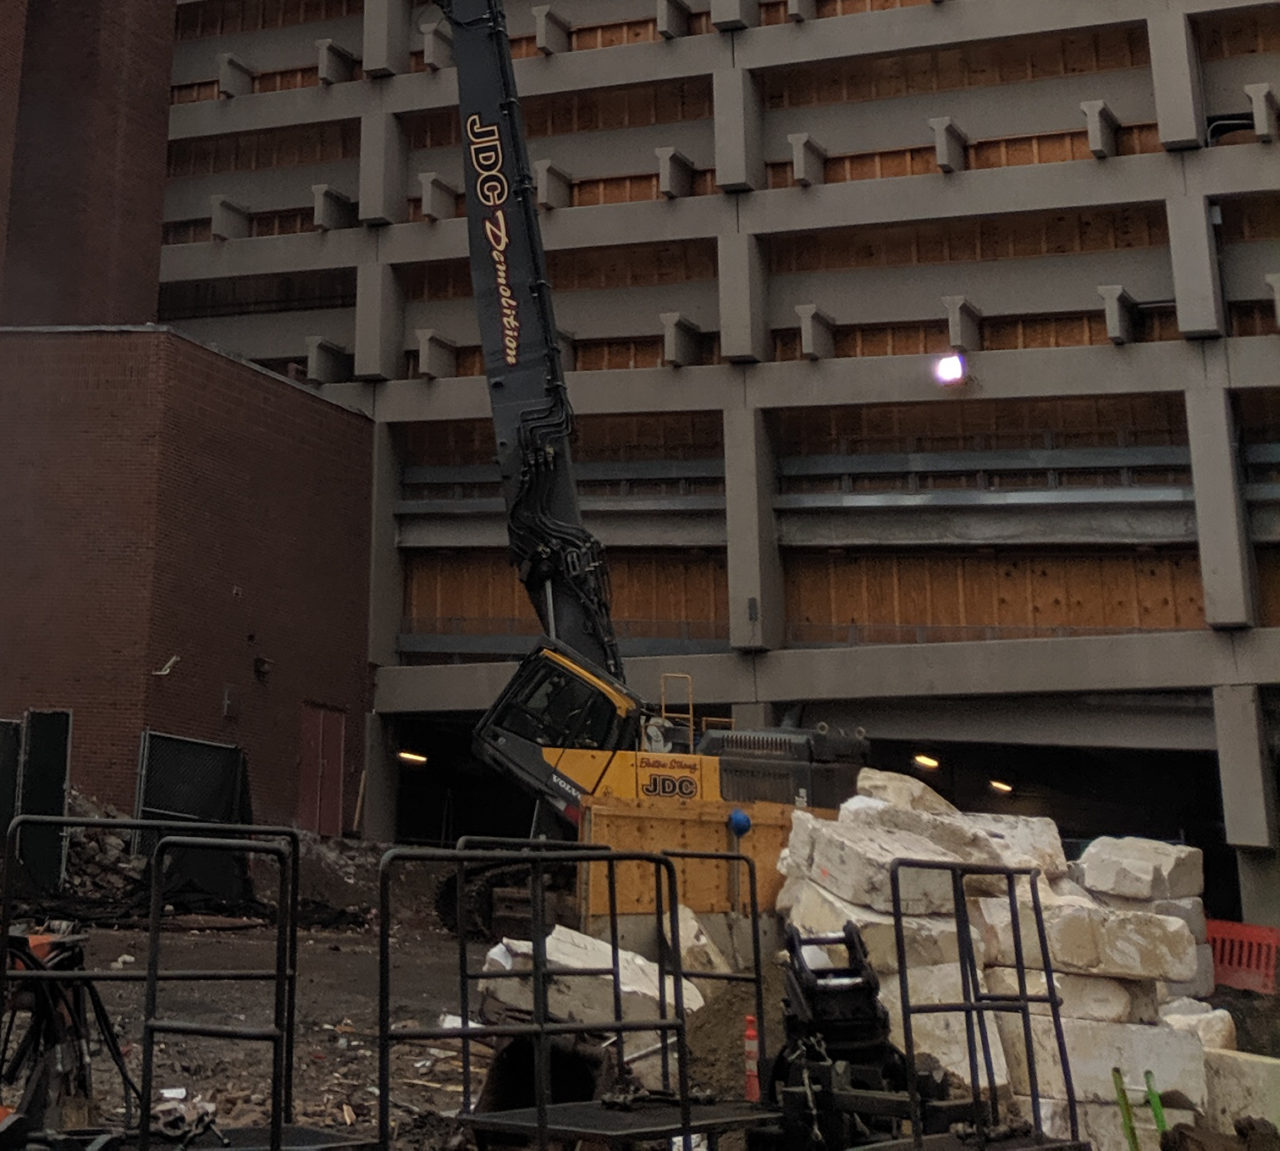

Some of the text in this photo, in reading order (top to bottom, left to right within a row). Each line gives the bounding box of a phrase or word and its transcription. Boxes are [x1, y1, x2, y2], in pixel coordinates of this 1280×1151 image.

[467, 114, 519, 365] JDC Demolition
[642, 774, 697, 798] JDC
